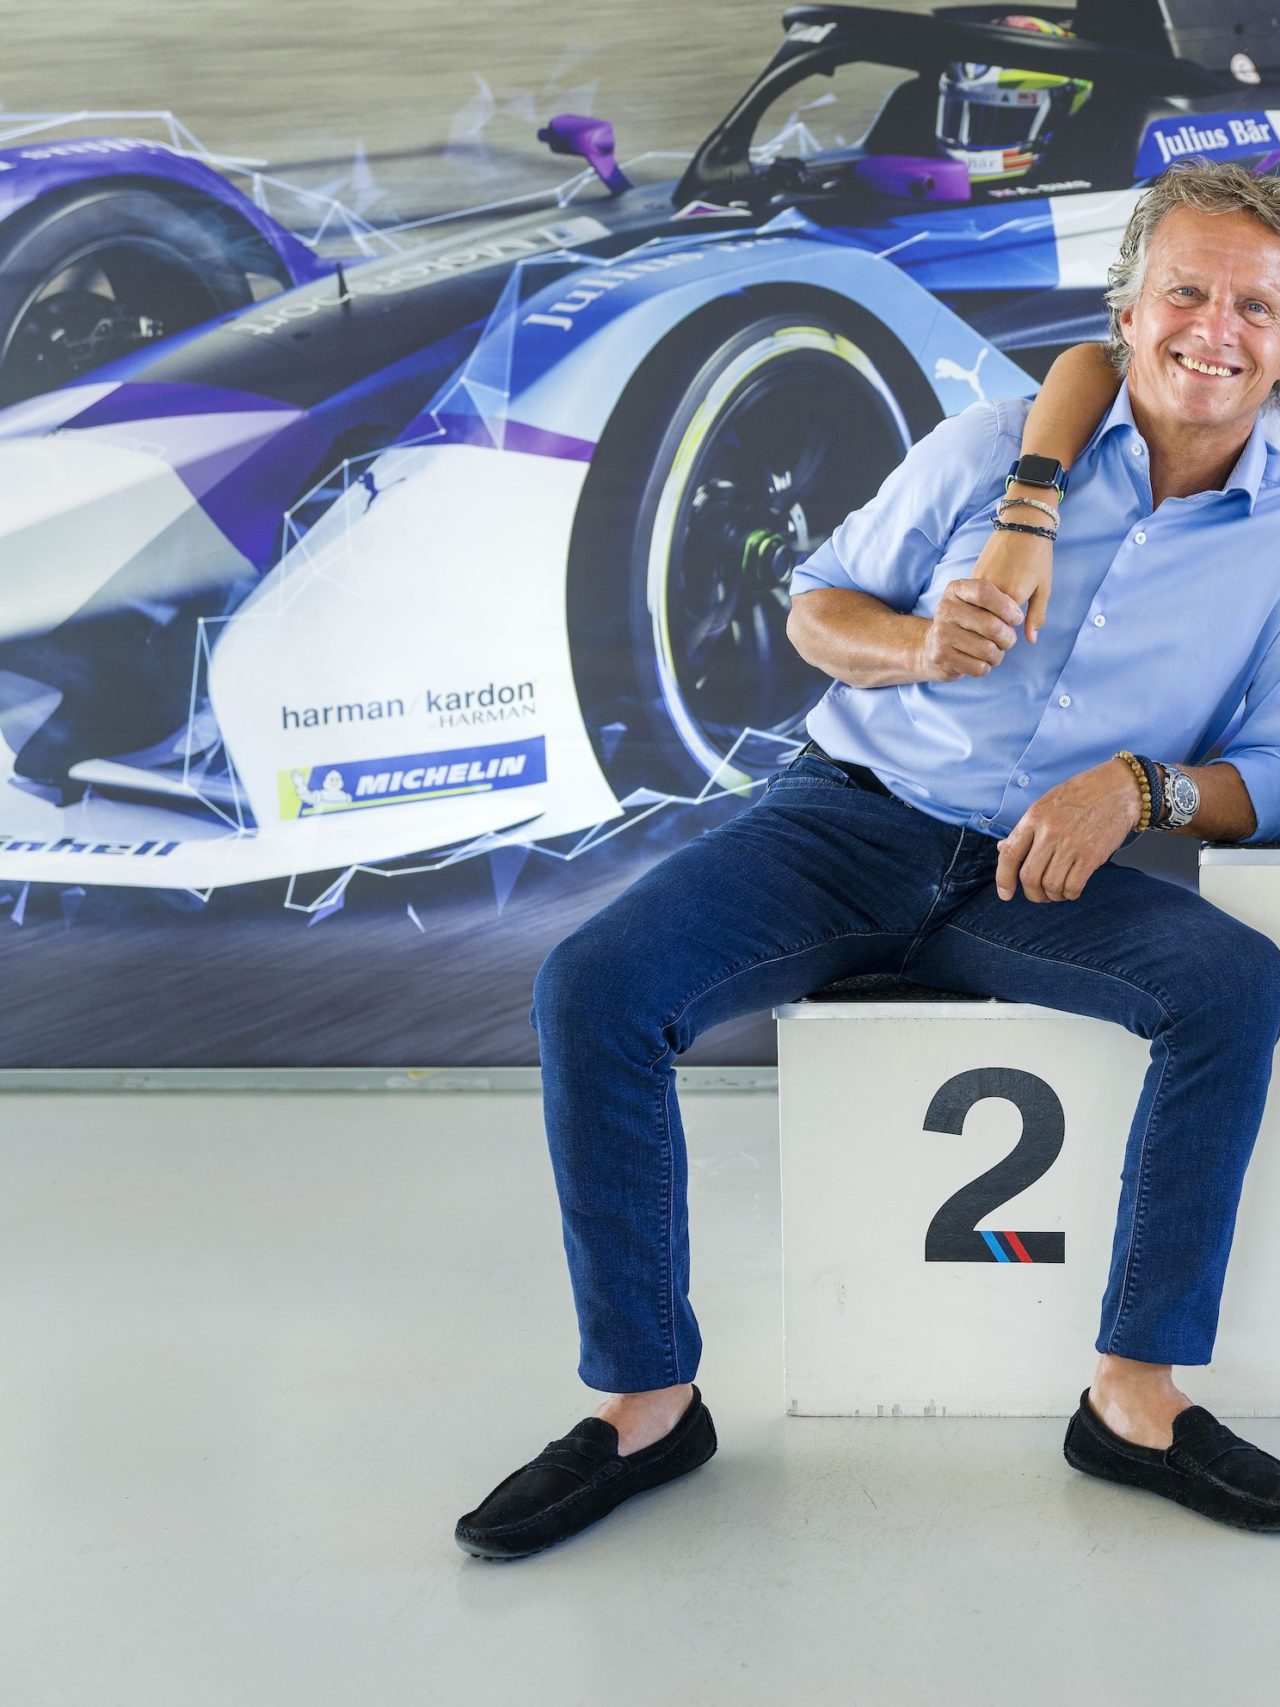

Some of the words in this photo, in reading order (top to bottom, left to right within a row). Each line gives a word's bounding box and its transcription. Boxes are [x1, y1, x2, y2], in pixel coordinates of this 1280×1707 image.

[1153, 125, 1229, 164] Julius
[1228, 119, 1272, 146] Bär
[282, 699, 404, 730] harman
[426, 682, 534, 713] kardon
[439, 703, 535, 728] HARMAN
[355, 755, 526, 796] MICHELIN
[922, 1066, 1066, 1264] 2
